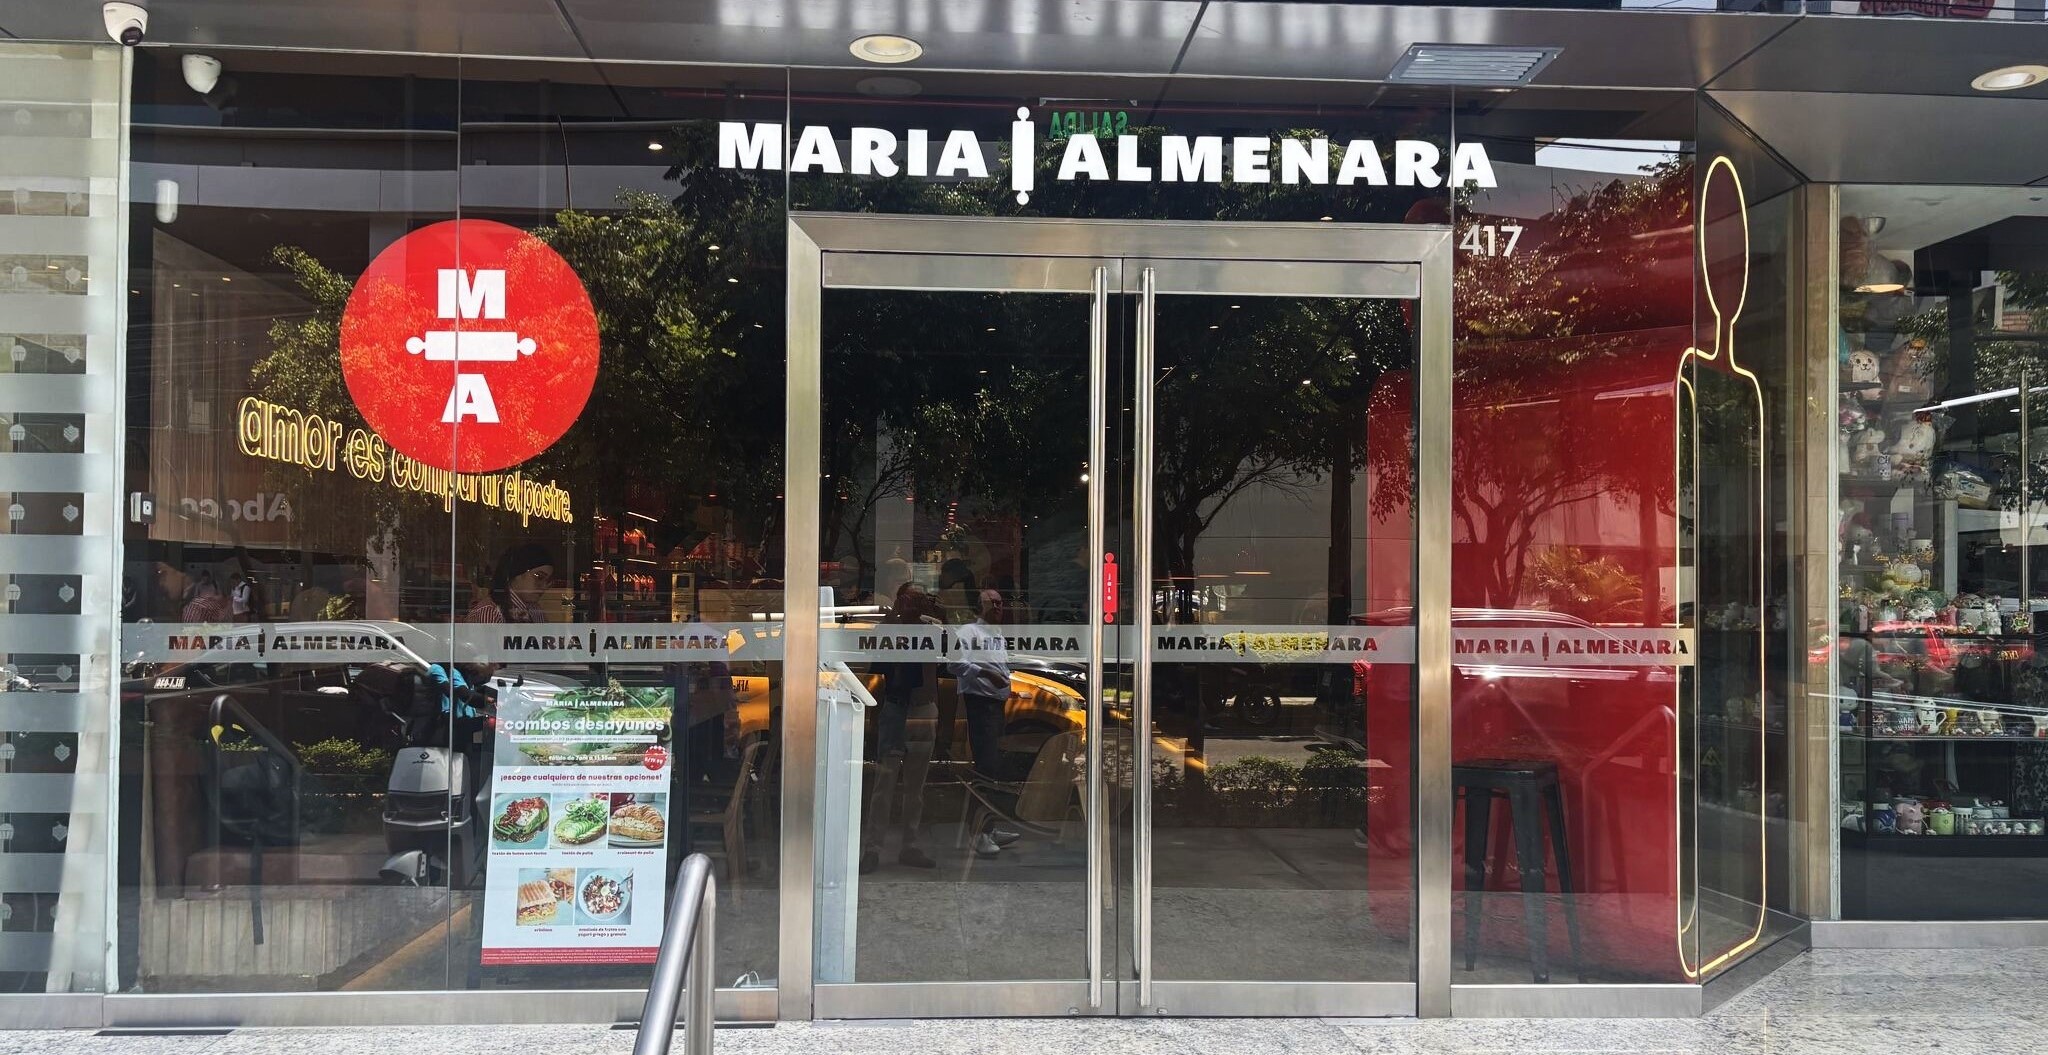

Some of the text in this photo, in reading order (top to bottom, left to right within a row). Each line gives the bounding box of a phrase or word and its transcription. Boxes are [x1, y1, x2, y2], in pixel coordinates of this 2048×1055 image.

[718, 121, 1498, 188] MARIA ALMENARA
[1459, 224, 1523, 258] 417
[437, 269, 506, 319] M
[441, 373, 500, 423] A
[238, 396, 343, 472] amor
[346, 428, 386, 483] es
[168, 635, 406, 650] MARIA ALMENARA
[503, 635, 583, 650] MARIA
[858, 636, 1080, 651] MARIA ALMENARA
[1157, 636, 1378, 651] MARIA ALMENARA
[1455, 639, 1688, 654] MARIA ALMENARA
[504, 716, 665, 734] combos desayunos
[533, 773, 575, 782] cualquiera
[576, 773, 587, 781] de
